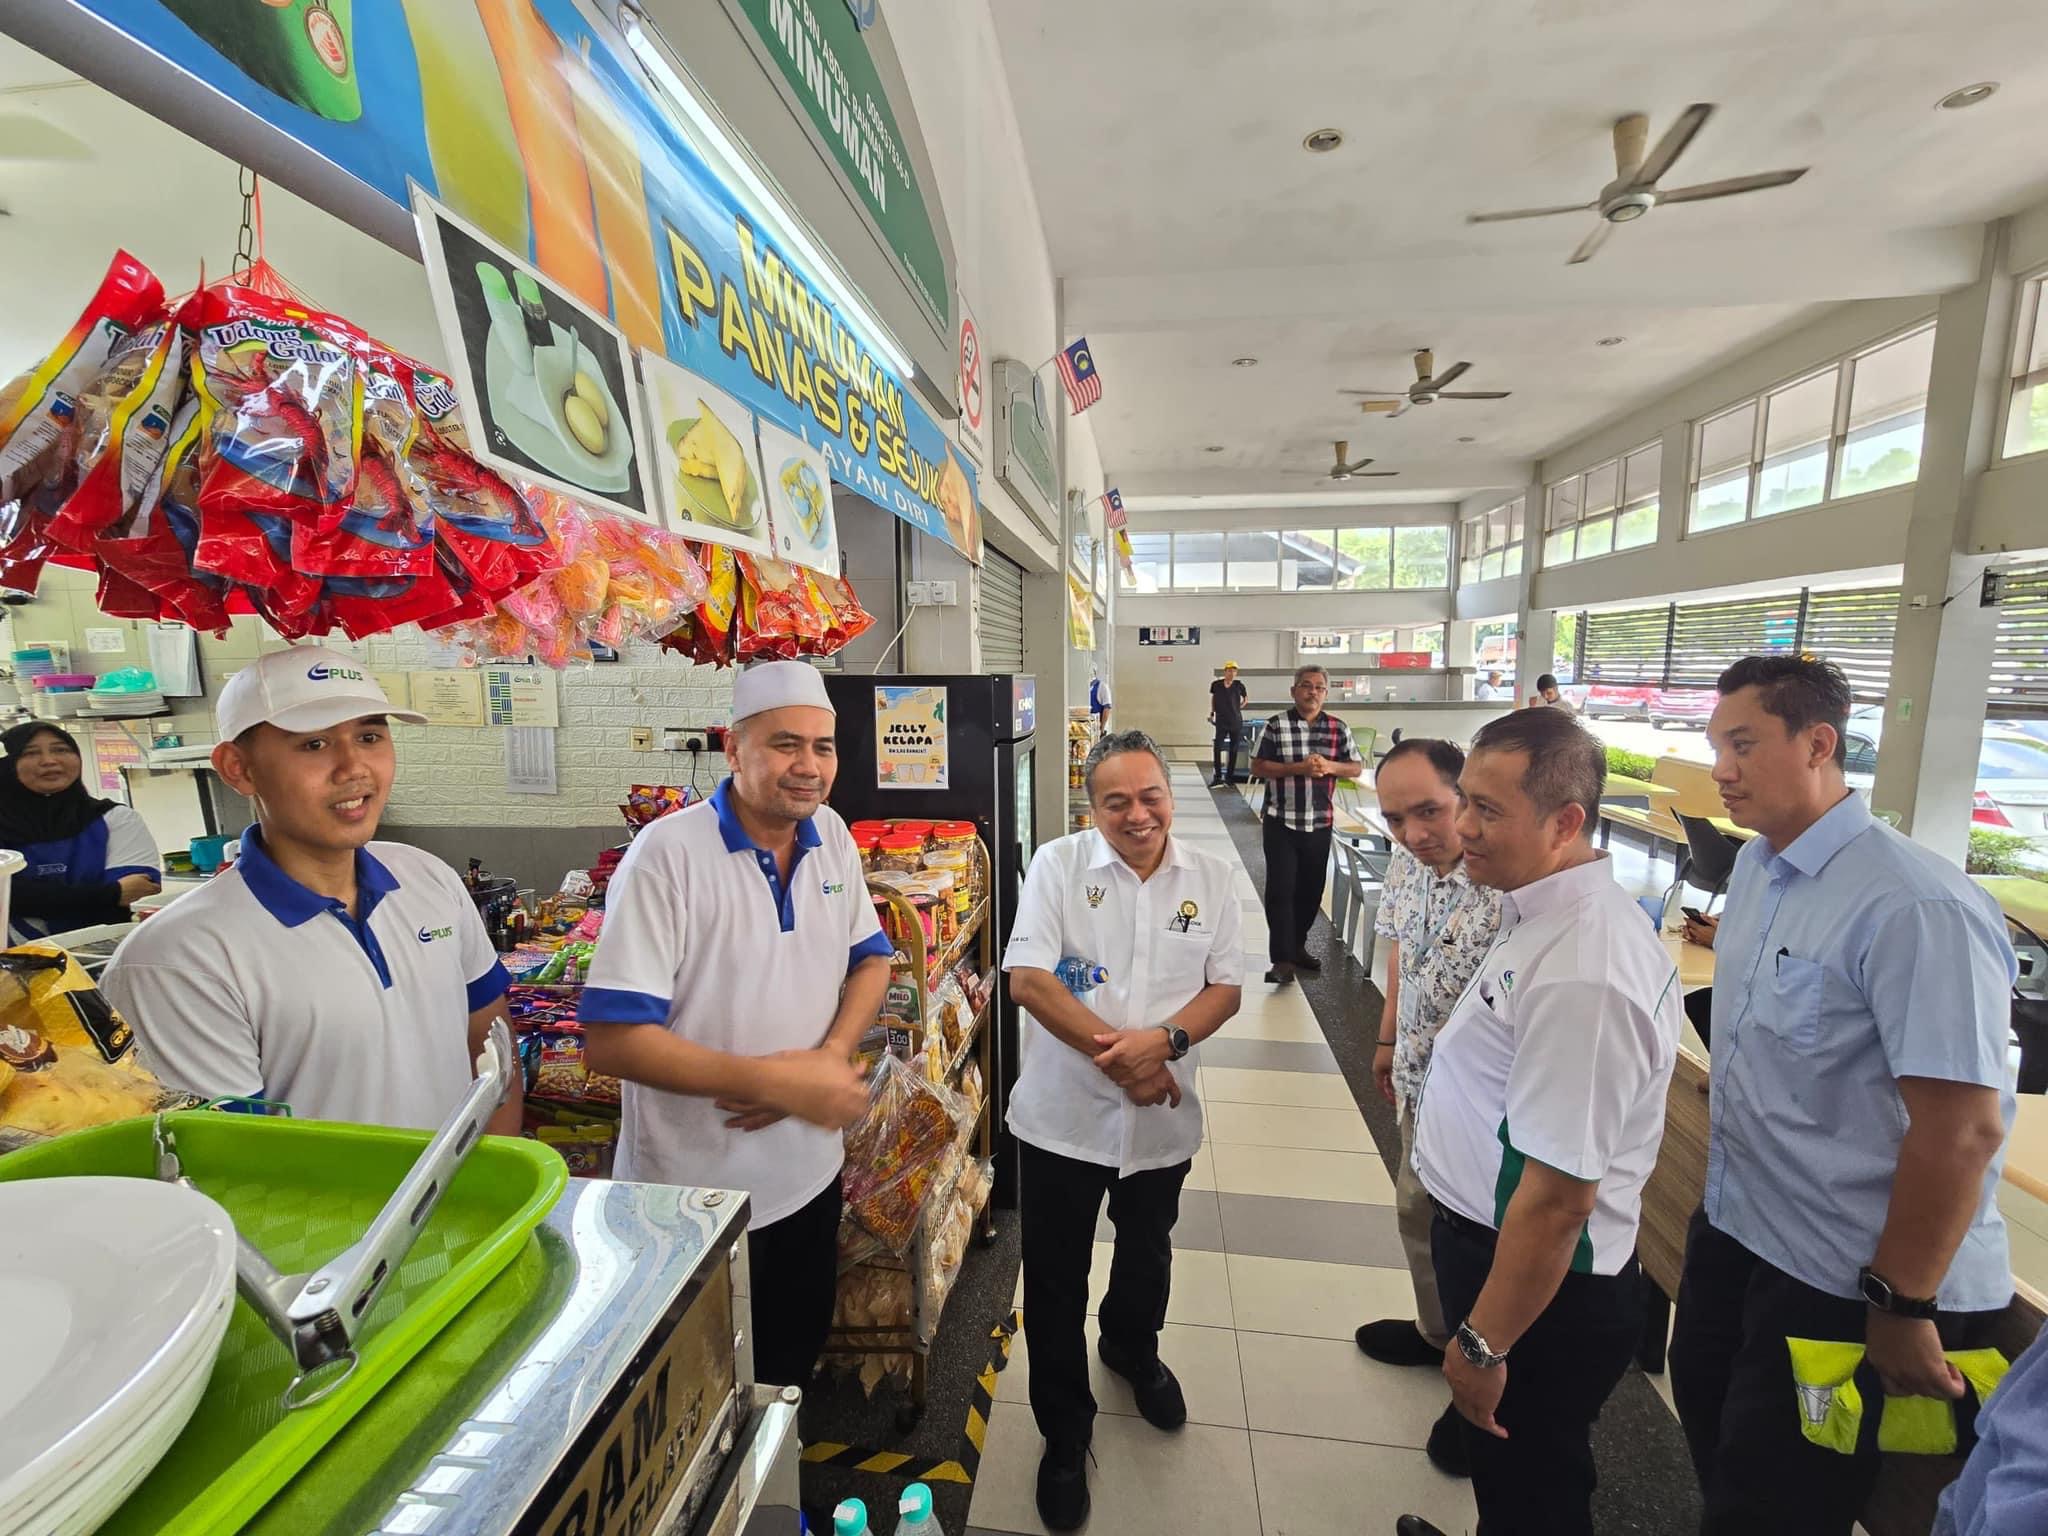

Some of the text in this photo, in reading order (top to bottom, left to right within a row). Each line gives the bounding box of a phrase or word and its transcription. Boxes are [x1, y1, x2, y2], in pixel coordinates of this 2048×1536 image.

[822, 39, 852, 105] ABDUL
[769, 0, 886, 214] MINUMAN
[209, 319, 299, 347] Udang
[736, 214, 908, 440] MINUMAN
[662, 217, 842, 438] PANAS
[846, 389, 871, 455] &
[875, 416, 945, 512] SEJUK
[894, 489, 929, 526] DIRI
[329, 667, 363, 681] PLUS
[883, 735, 933, 746] KELAPA
[889, 724, 927, 734] JELLY
[431, 926, 453, 941] PLUS
[888, 991, 910, 1002] MILO
